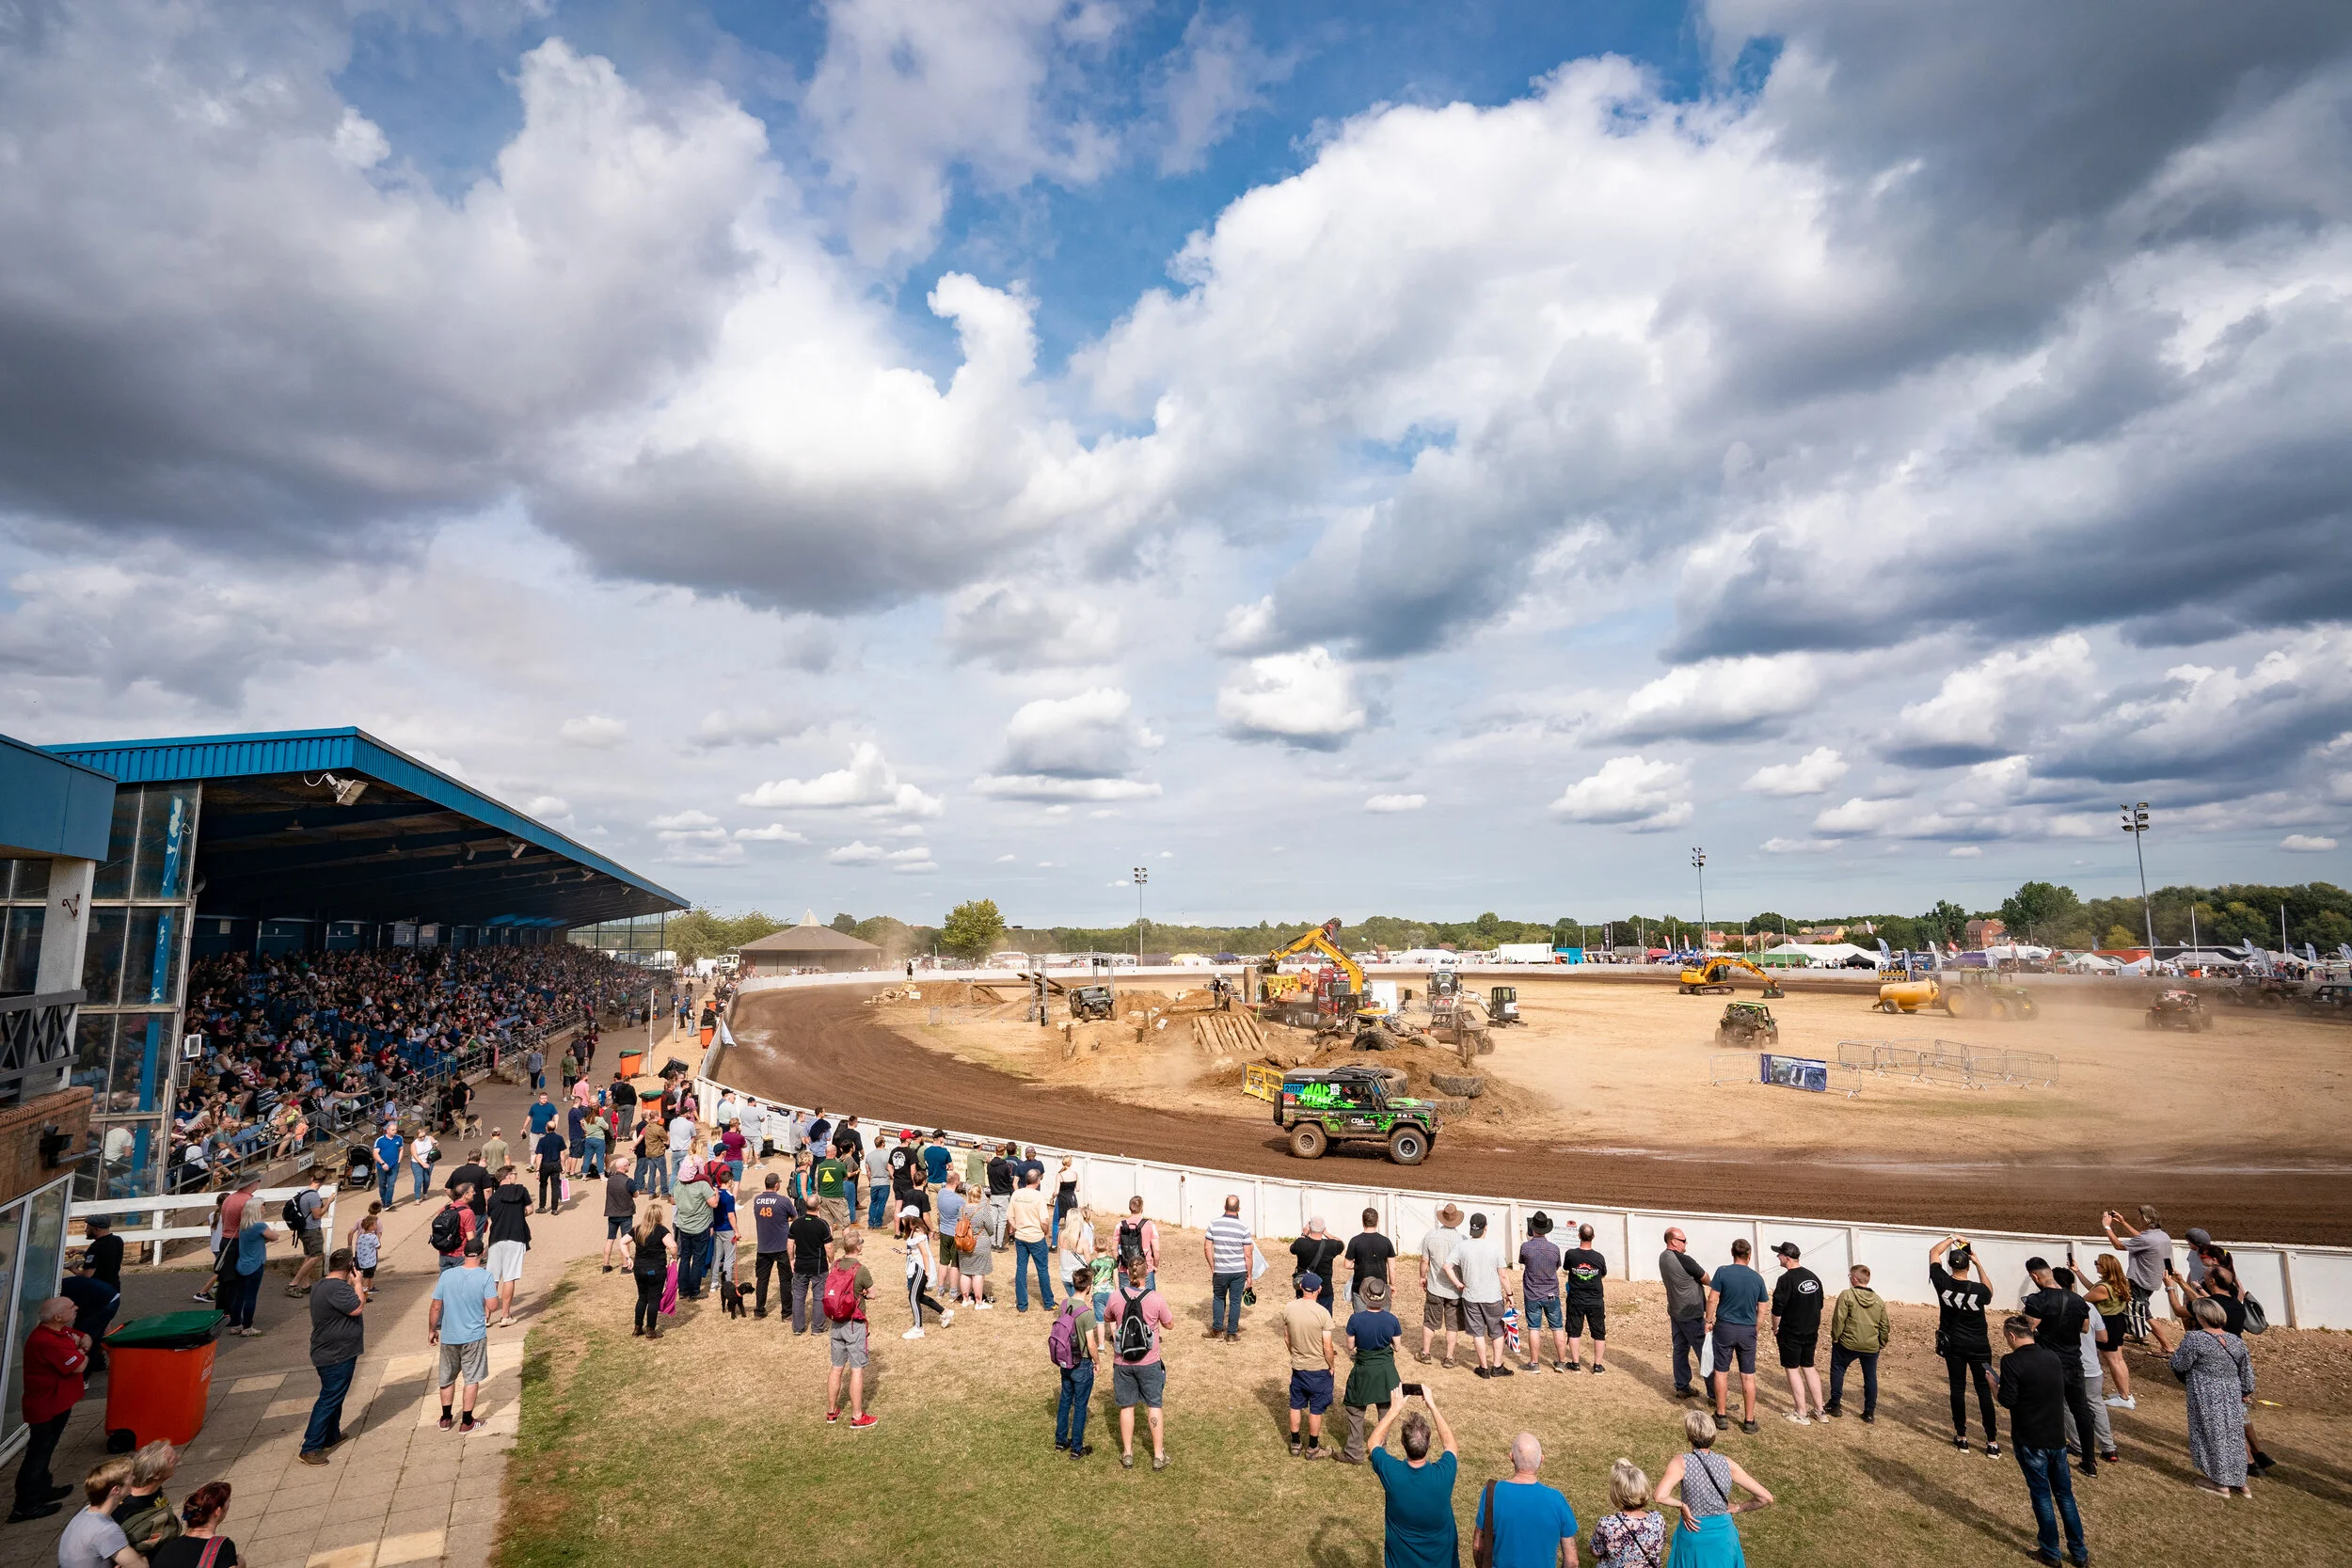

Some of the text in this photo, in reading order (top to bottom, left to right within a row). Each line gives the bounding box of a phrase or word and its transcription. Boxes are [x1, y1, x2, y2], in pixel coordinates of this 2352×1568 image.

[1285, 1085, 1303, 1094] 2017
[1300, 1094, 1335, 1104] ATTACK
[299, 1156, 312, 1168] BLOCK
[759, 1207, 772, 1218] 48
